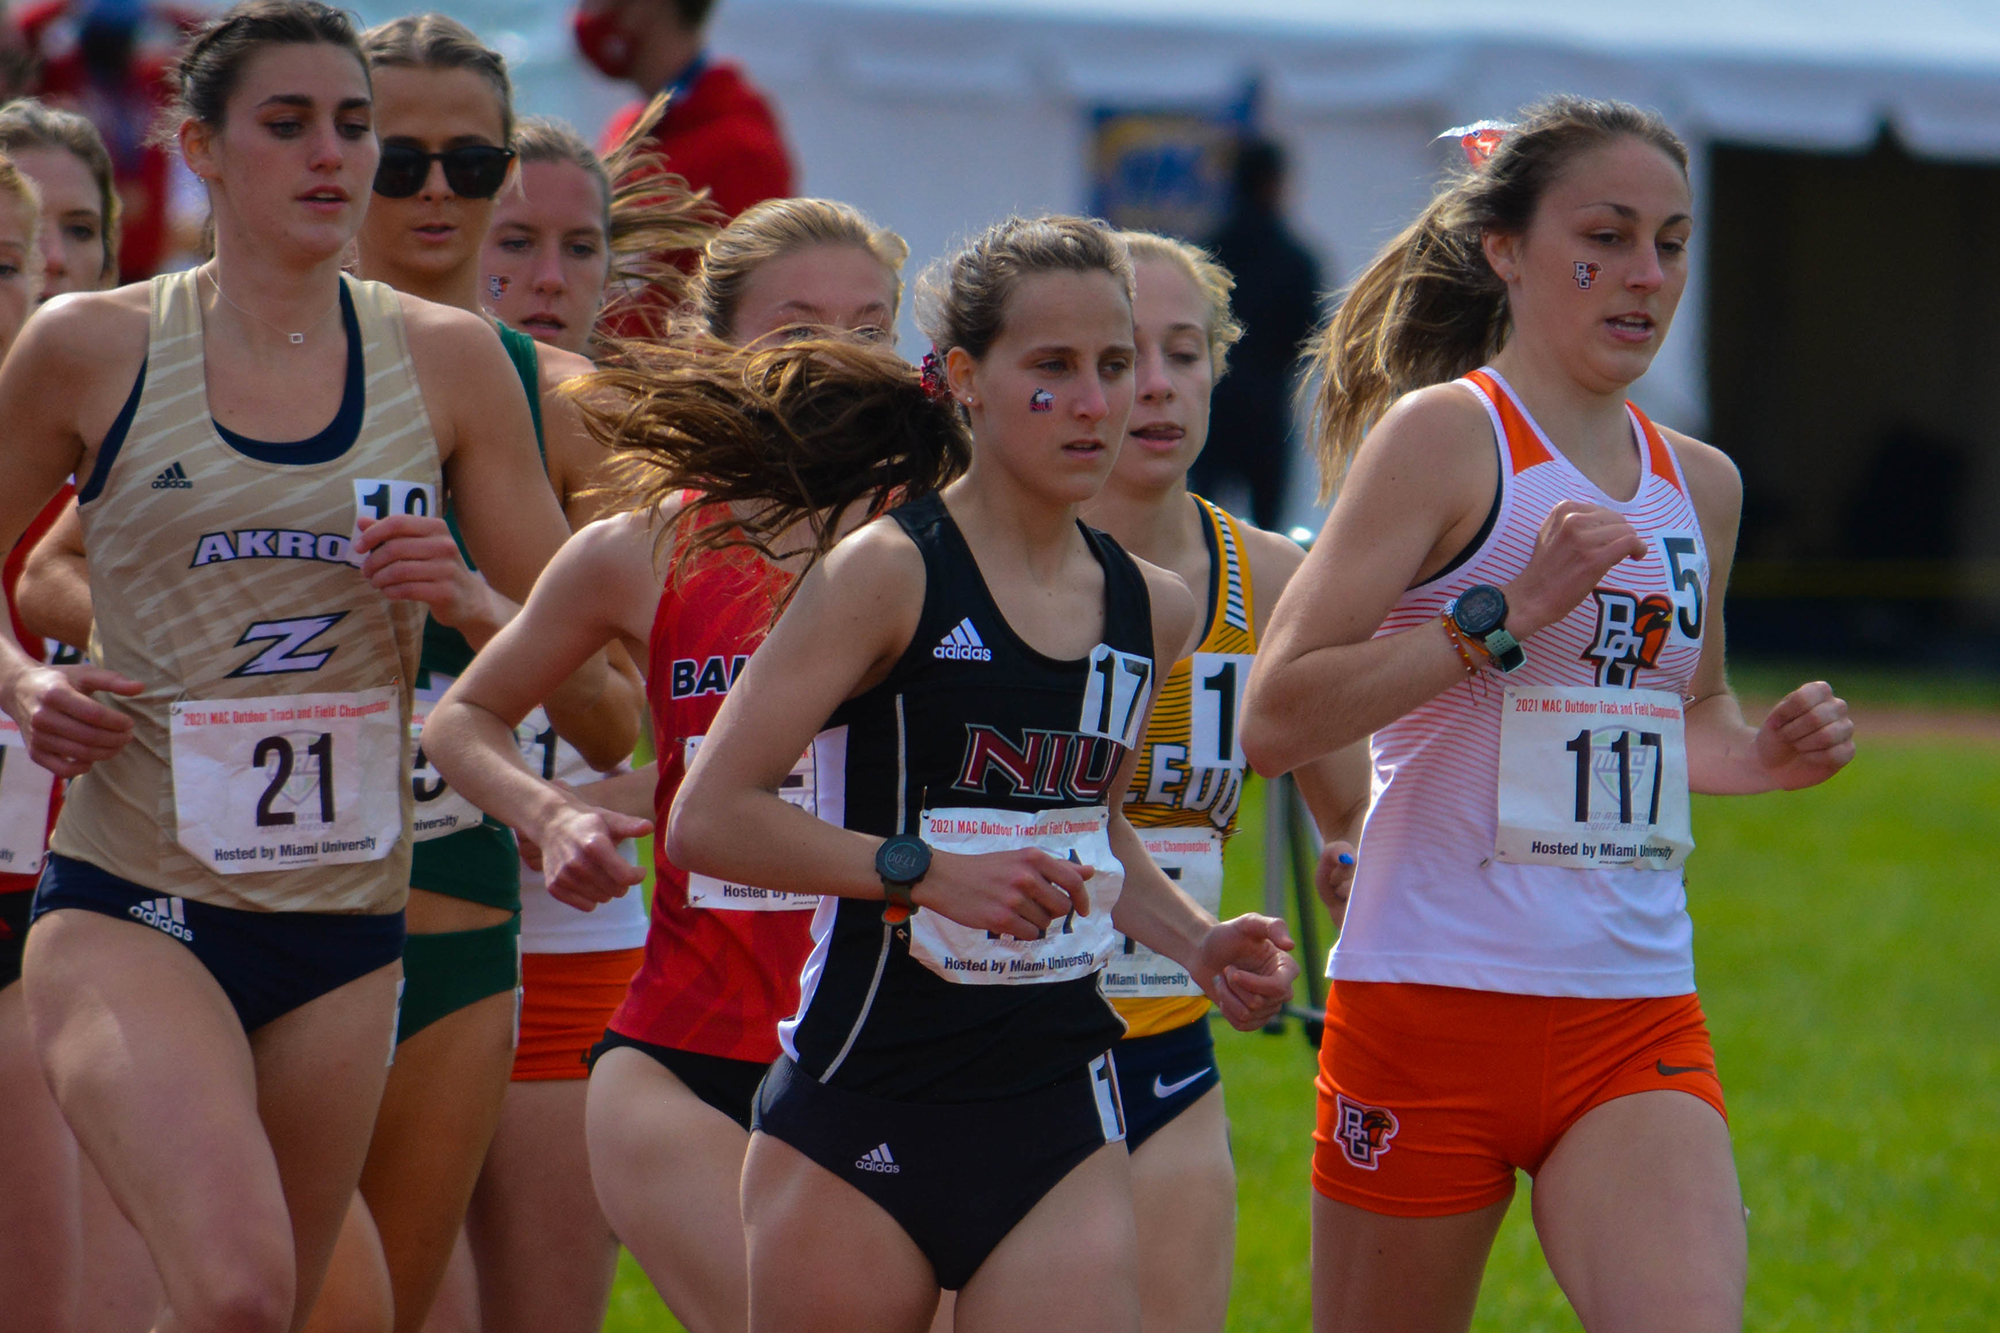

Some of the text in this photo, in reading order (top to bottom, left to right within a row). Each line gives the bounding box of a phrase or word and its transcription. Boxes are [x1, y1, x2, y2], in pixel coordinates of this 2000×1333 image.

[152, 478, 192, 489] adidas
[1663, 537, 1703, 639] 5
[933, 644, 991, 662] adidas
[1095, 651, 1149, 741] 17
[184, 712, 206, 726] 2021
[210, 711, 230, 725] MAC
[233, 709, 267, 724] Outdoor
[270, 708, 295, 722] Track
[297, 707, 312, 719] and
[315, 705, 336, 718] Field
[1516, 699, 1538, 712] 2021
[1542, 700, 1562, 713] MAC
[1565, 700, 1597, 714] Outdoor
[1600, 701, 1619, 714] Track
[1621, 703, 1633, 715] and
[1635, 703, 1649, 716] Field
[951, 723, 1123, 802] NIU
[253, 733, 335, 826] 21
[1566, 729, 1663, 825] 117
[413, 814, 459, 832] niversity
[930, 819, 954, 834] 2021
[958, 820, 978, 834] MAC
[981, 822, 1012, 836] Outdoor
[1050, 820, 1064, 834] Field
[215, 836, 377, 861] Hosted by Miami University
[1144, 840, 1211, 854] Field Championships
[1531, 841, 1674, 860] Hosted by Miami University
[723, 884, 767, 898] Hosted
[129, 905, 194, 941] adidas
[945, 957, 987, 972] Hosted
[991, 958, 1006, 974] by
[1010, 959, 1045, 972] Miami
[1048, 951, 1094, 970] University
[1106, 972, 1189, 986] Miami University
[855, 1160, 900, 1174] adidas
